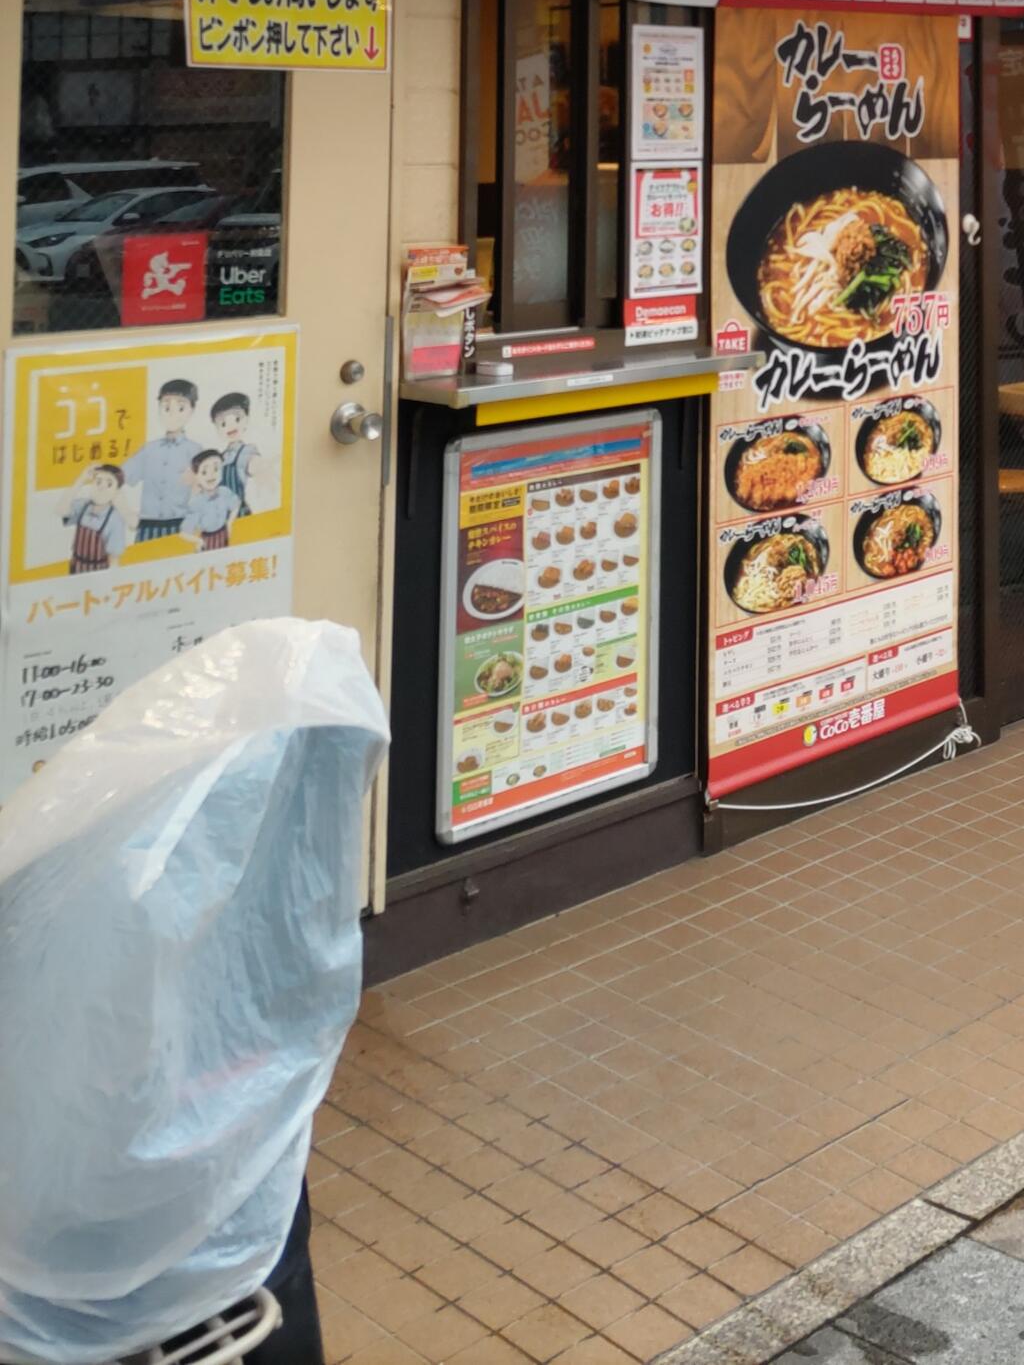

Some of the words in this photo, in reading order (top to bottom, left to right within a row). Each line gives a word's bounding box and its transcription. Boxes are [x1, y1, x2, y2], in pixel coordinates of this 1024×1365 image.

[777, 23, 878, 84] カレー
[797, 75, 922, 138] らーめん
[219, 287, 265, 306] Eats
[220, 266, 266, 285] Uber
[892, 294, 950, 336] 757円
[717, 336, 745, 352] TAKE
[755, 342, 940, 408] カレーらーめん
[820, 698, 886, 740] CoCo壱番屋
